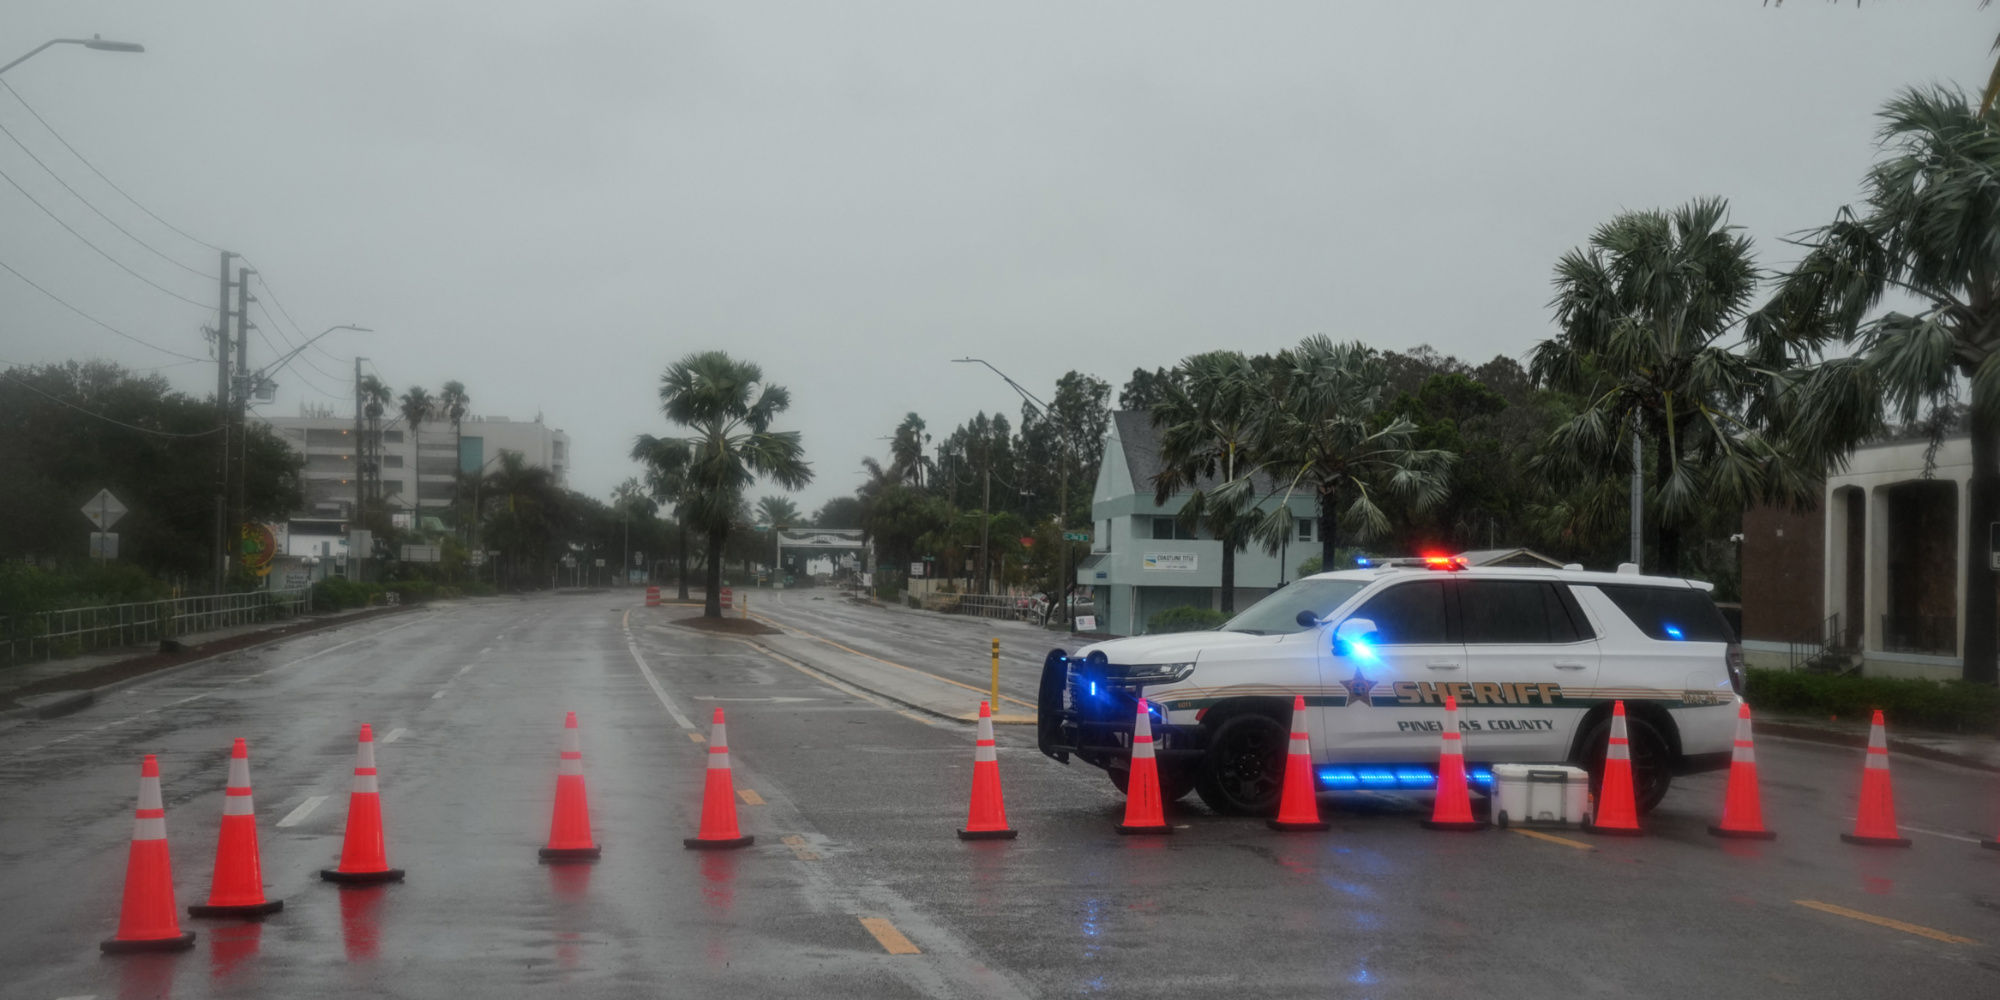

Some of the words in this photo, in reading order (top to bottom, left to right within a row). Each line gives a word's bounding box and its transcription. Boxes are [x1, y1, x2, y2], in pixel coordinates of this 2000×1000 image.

[1392, 681, 1562, 705] SHERIFF
[1397, 720, 1482, 731] PINELAS
[1487, 720, 1553, 731] COUNTY
